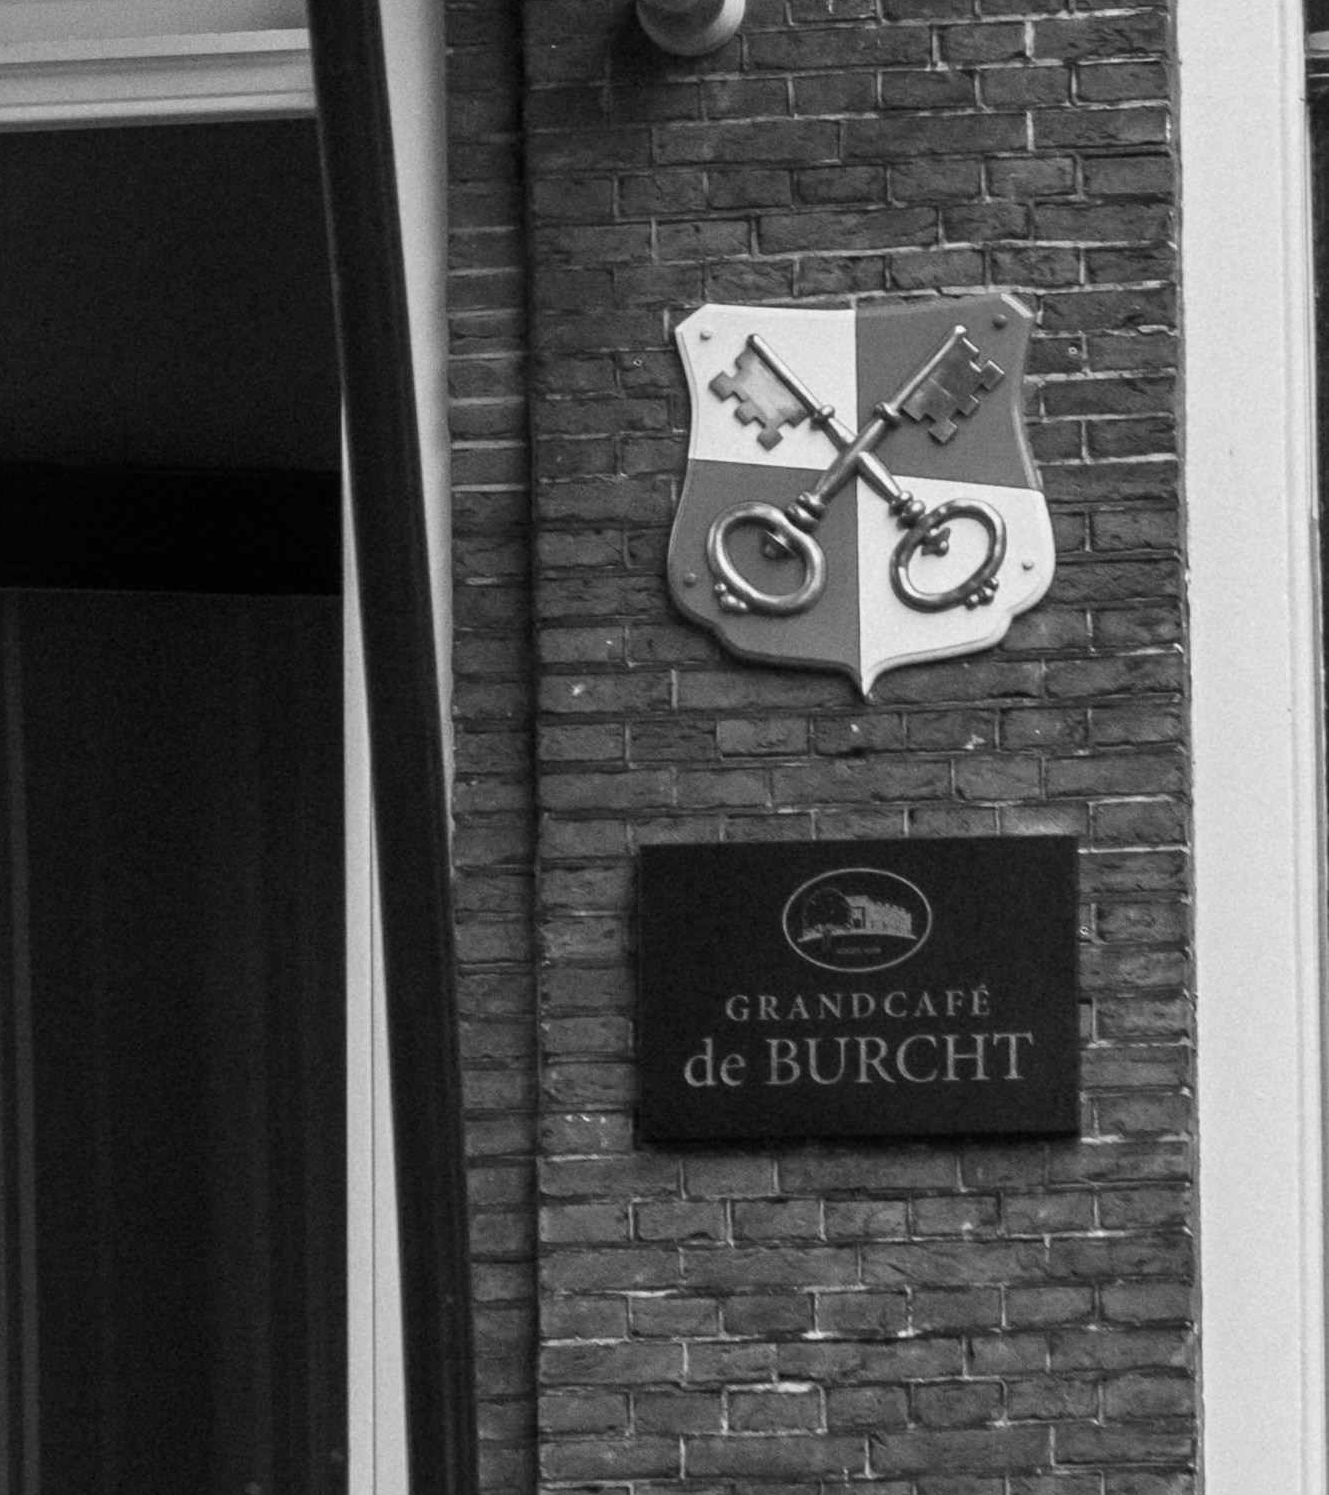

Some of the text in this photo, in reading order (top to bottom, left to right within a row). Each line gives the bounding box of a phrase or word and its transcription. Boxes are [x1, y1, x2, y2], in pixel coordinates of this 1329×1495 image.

[725, 985, 992, 1021] GRANDCAFÉ
[684, 1031, 1035, 1087] de BURCHT
